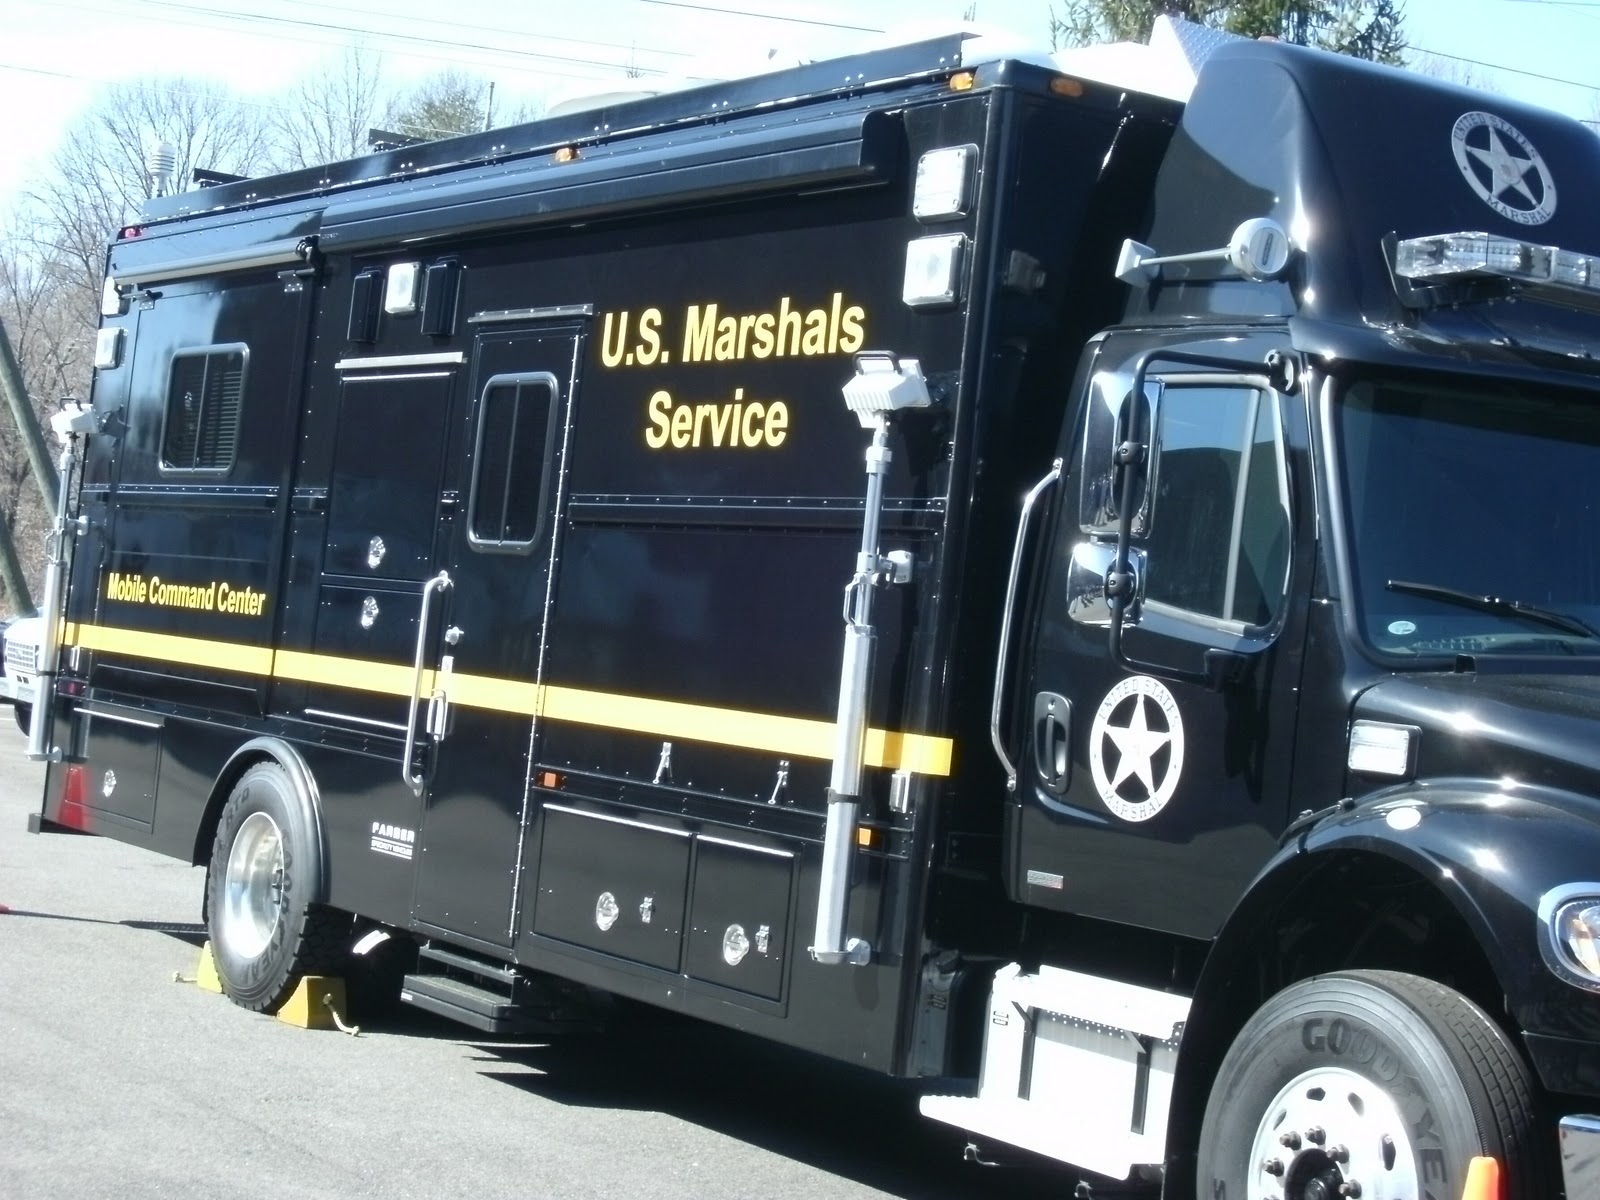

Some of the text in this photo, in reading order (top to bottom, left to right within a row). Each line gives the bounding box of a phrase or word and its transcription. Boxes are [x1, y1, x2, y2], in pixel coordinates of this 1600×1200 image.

[1454, 112, 1539, 158] UNITED STATES
[1486, 194, 1552, 224] MARSHAL
[601, 292, 865, 367] U.S. Marshals
[646, 388, 789, 449] Service
[107, 572, 267, 616] Mobile Command Center
[1098, 678, 1180, 728] UNITED STATES
